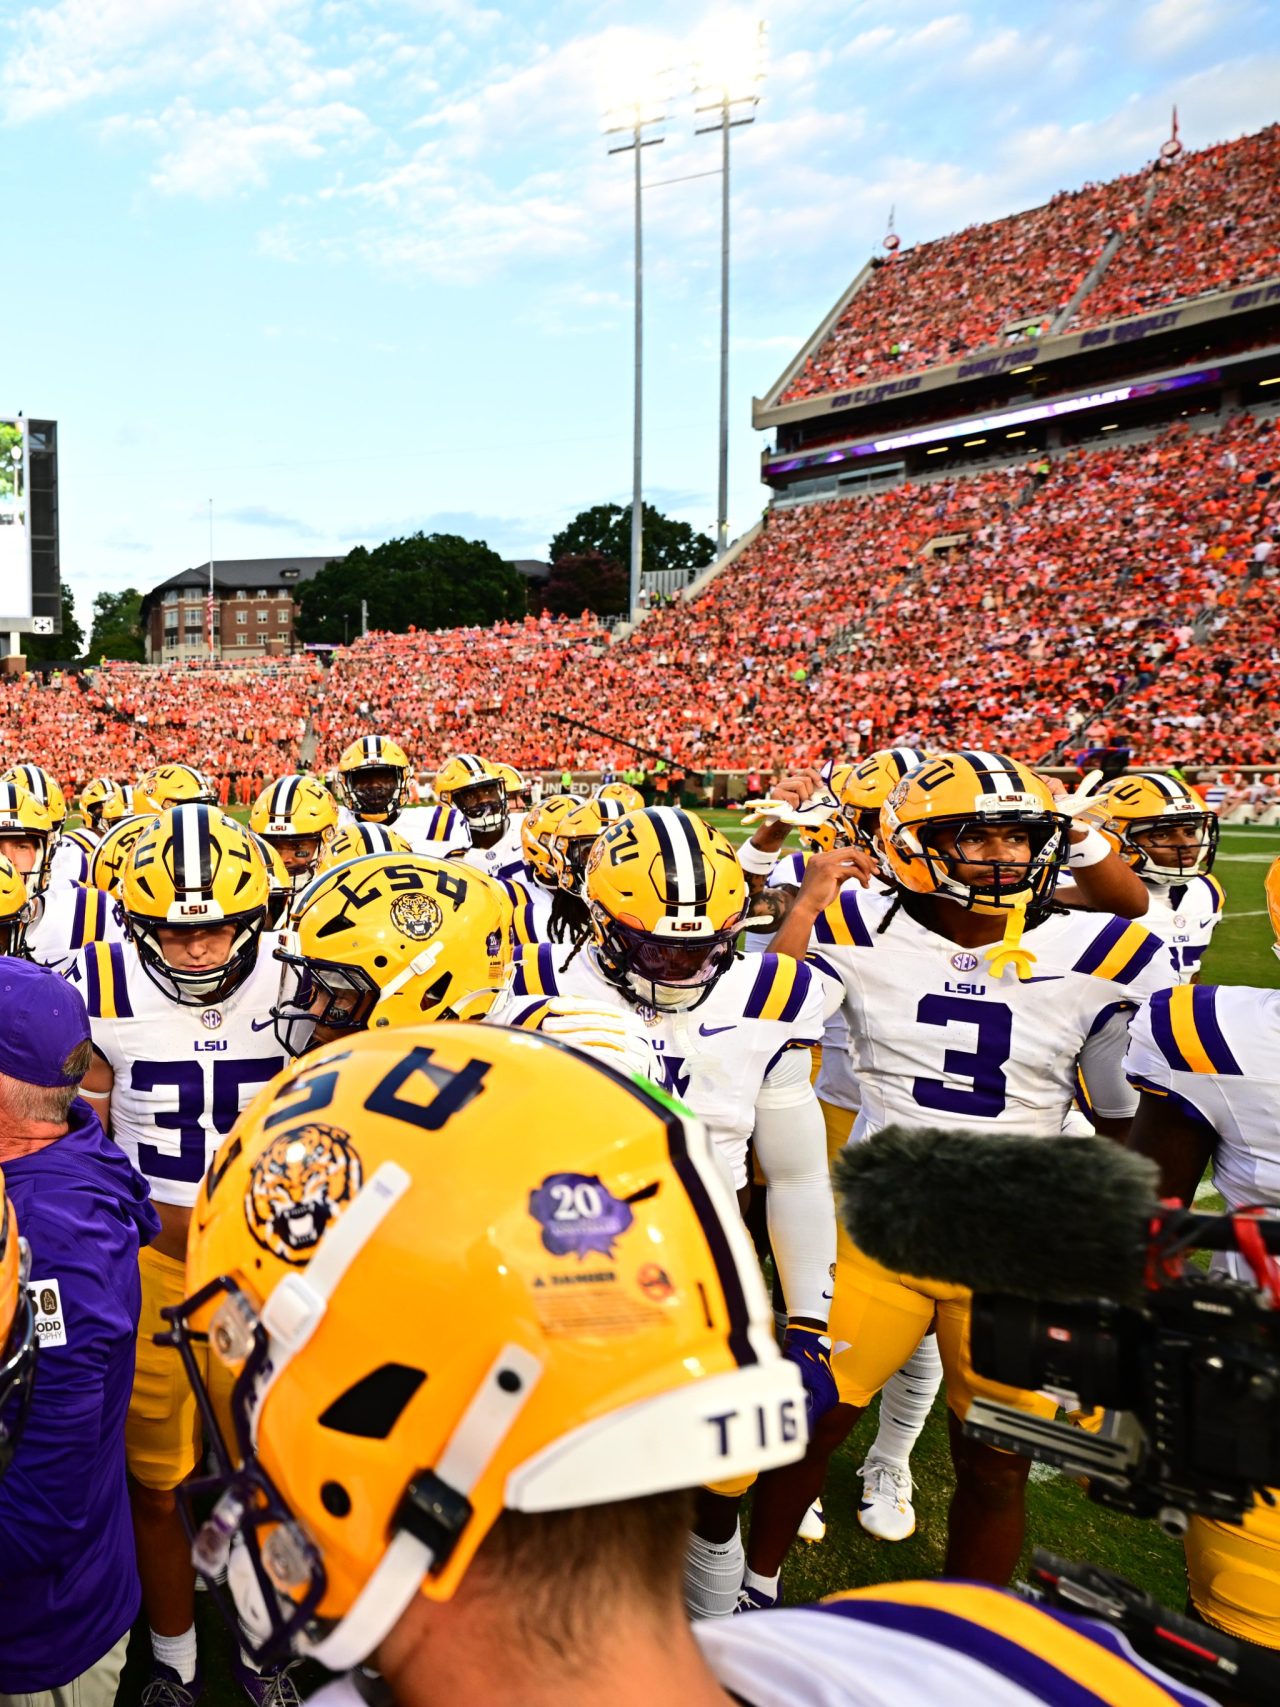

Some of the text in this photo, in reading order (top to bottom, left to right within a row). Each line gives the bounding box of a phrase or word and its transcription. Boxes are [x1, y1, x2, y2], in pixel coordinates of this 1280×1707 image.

[541, 783, 590, 795] UNIED
[338, 864, 468, 909] LSU
[180, 904, 209, 915] LSU
[671, 921, 702, 932] LSU
[1172, 935, 1190, 943] LSU
[944, 981, 986, 996] LSU
[201, 1009, 222, 1029] SEC
[193, 1040, 228, 1052] LSU
[912, 993, 1013, 1118] 3
[549, 1182, 603, 1222] 20
[36, 1321, 62, 1333] ODD
[39, 1332, 63, 1341] OPHY
